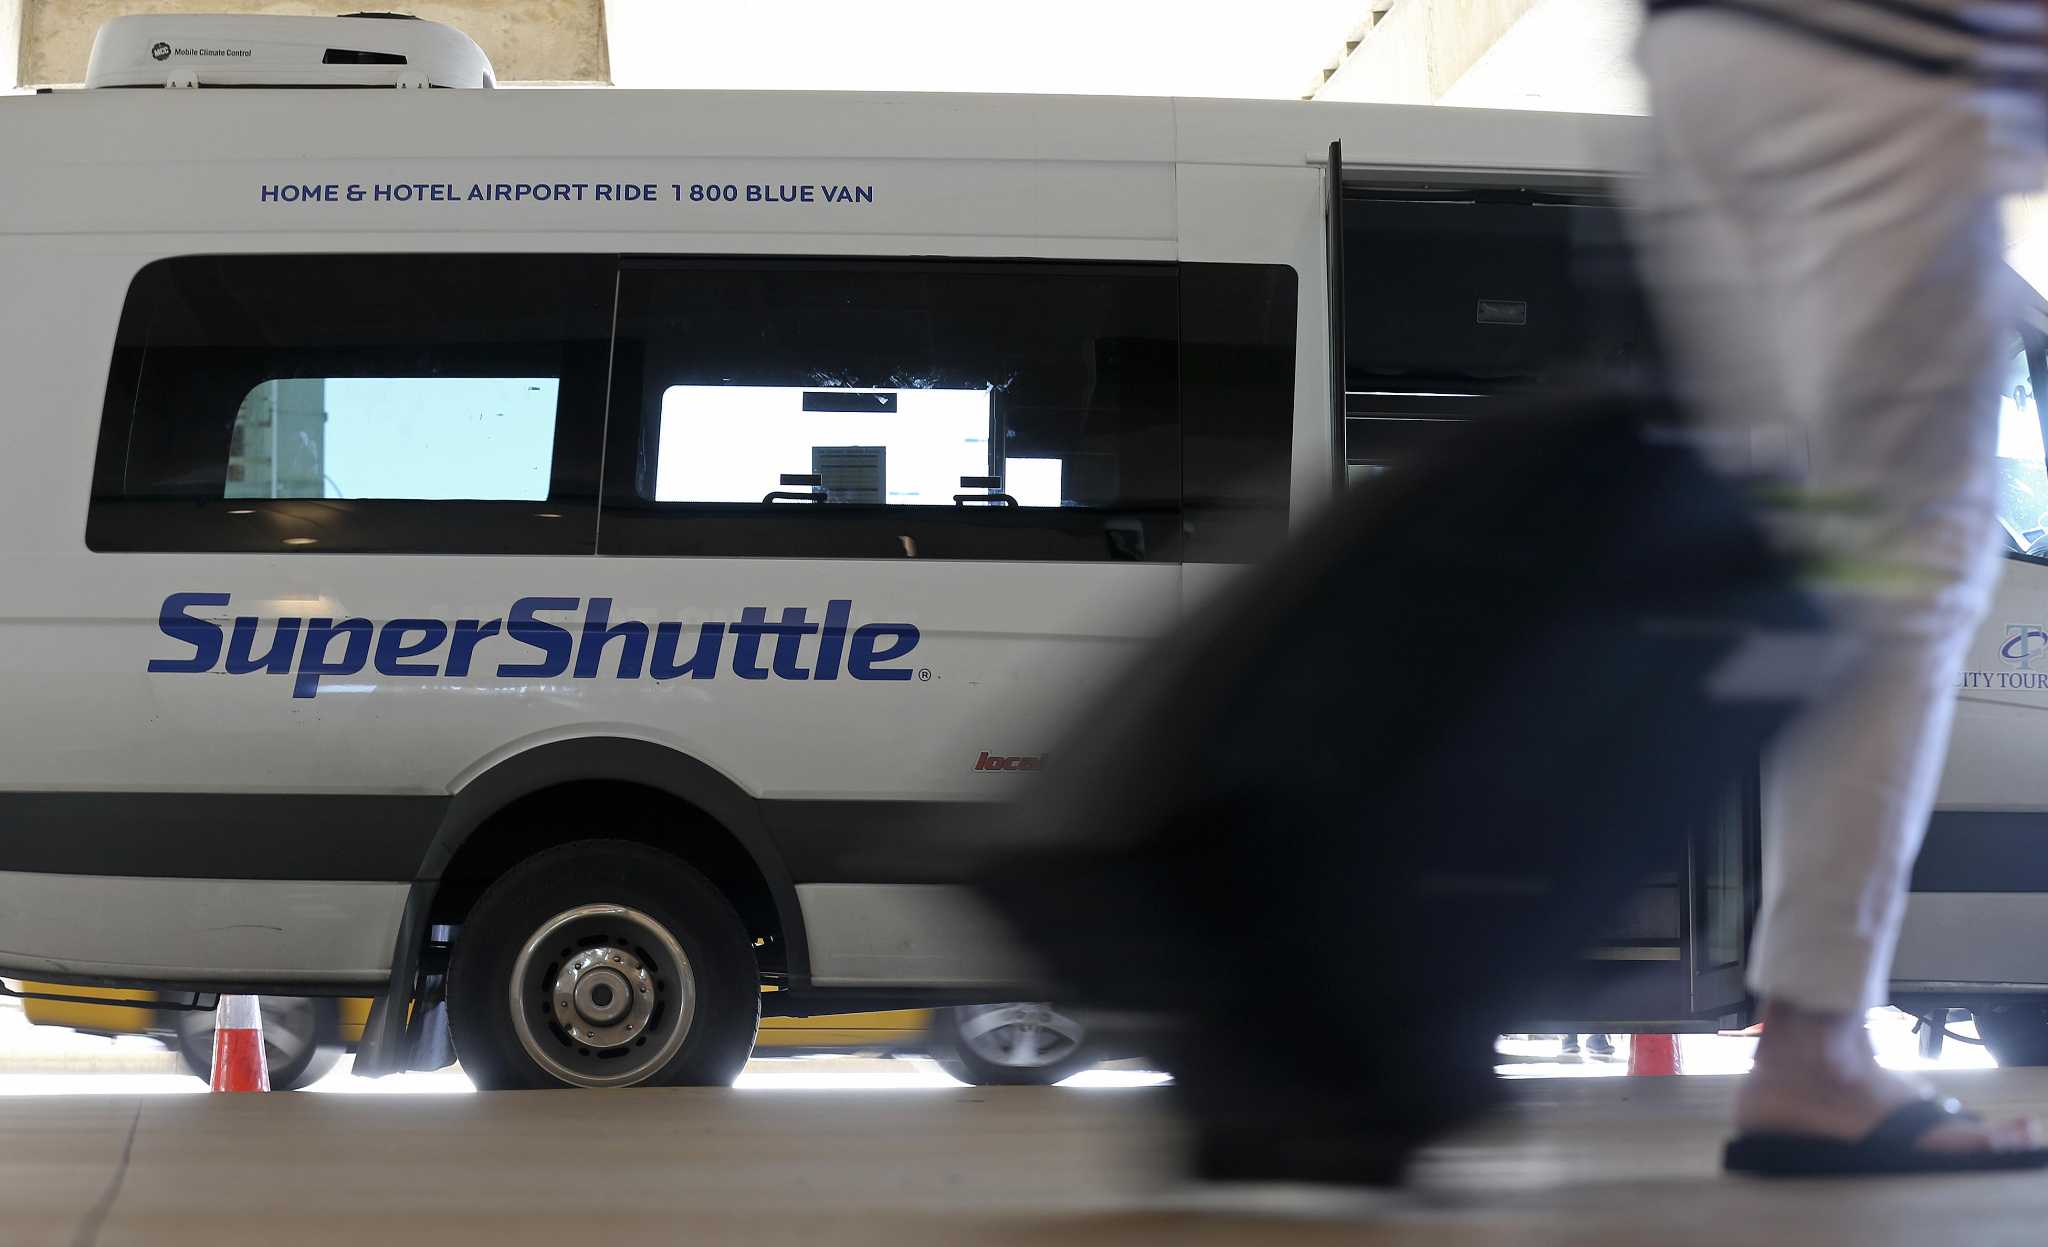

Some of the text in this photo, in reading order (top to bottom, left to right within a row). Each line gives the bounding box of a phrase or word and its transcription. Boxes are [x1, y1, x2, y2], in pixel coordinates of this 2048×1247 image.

[174, 48, 252, 57] Mobile Climate Control
[261, 184, 339, 202] HOME
[346, 184, 367, 202] &
[374, 183, 462, 202] HOTEL
[466, 183, 589, 201] AIRPORT
[595, 183, 658, 202] RIDE
[689, 184, 738, 202] 800
[746, 184, 815, 203] BLUE
[820, 185, 873, 203] VAN
[147, 592, 921, 699] SuperShuttle
[1953, 671, 1994, 688] ITY
[974, 751, 1048, 771] loca
